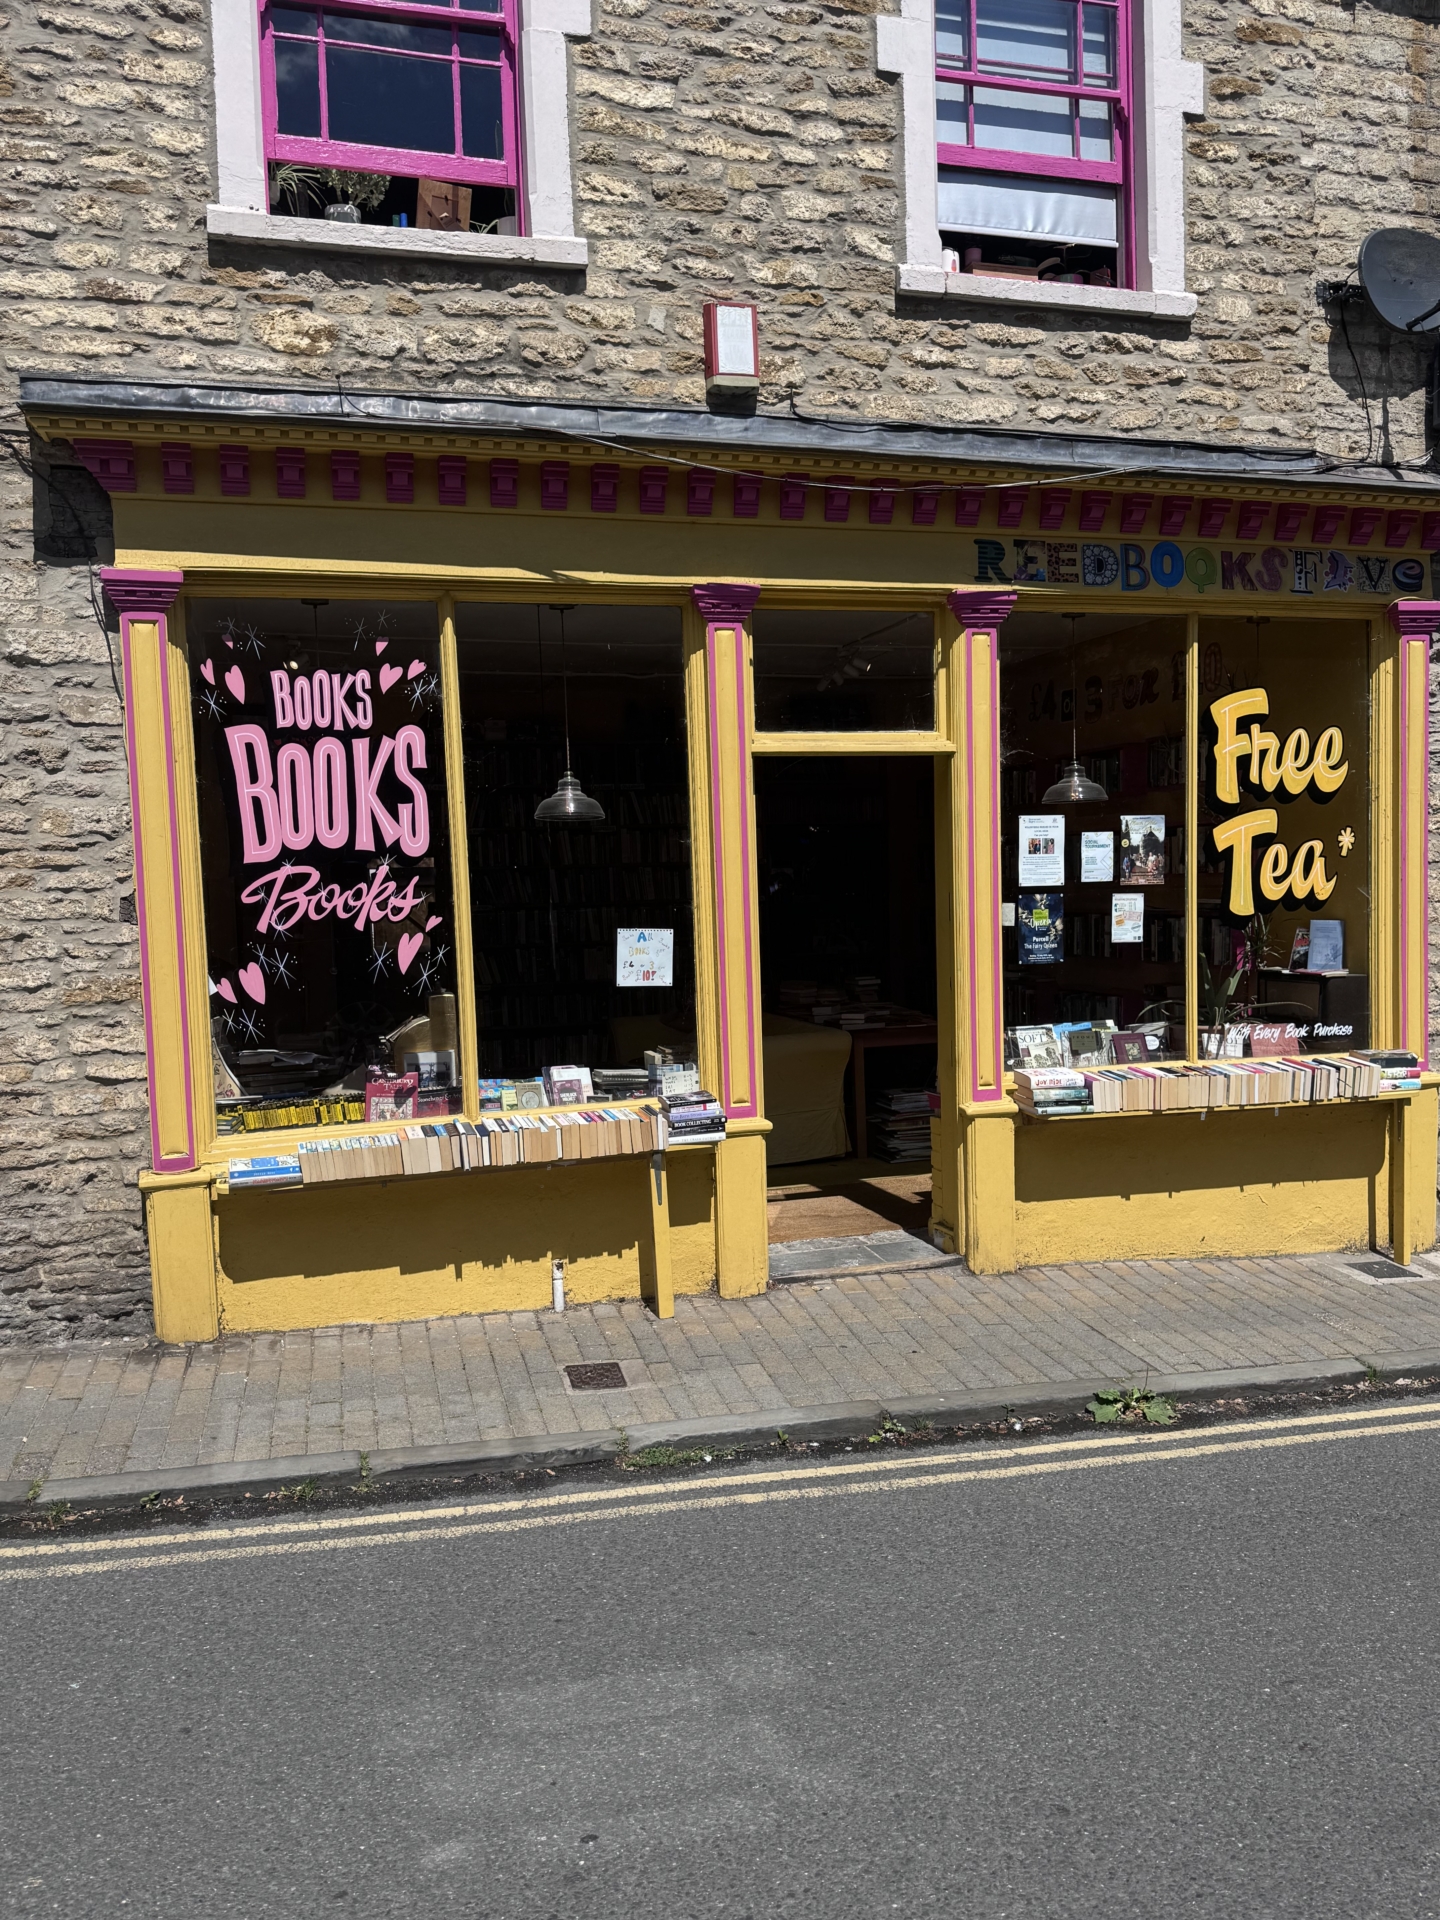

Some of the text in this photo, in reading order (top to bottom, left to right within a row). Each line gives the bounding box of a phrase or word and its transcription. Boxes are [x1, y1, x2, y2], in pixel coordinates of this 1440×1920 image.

[269, 669, 373, 731] BOOKS
[1085, 675, 1102, 724] 3
[1108, 666, 1160, 712] FOR
[1209, 687, 1349, 805] Free
[223, 723, 430, 864] BOOKS
[240, 864, 423, 934] Books
[1253, 1023, 1281, 1044] Every
[1284, 1022, 1310, 1039] Book
[1313, 1022, 1353, 1038] Purchase
